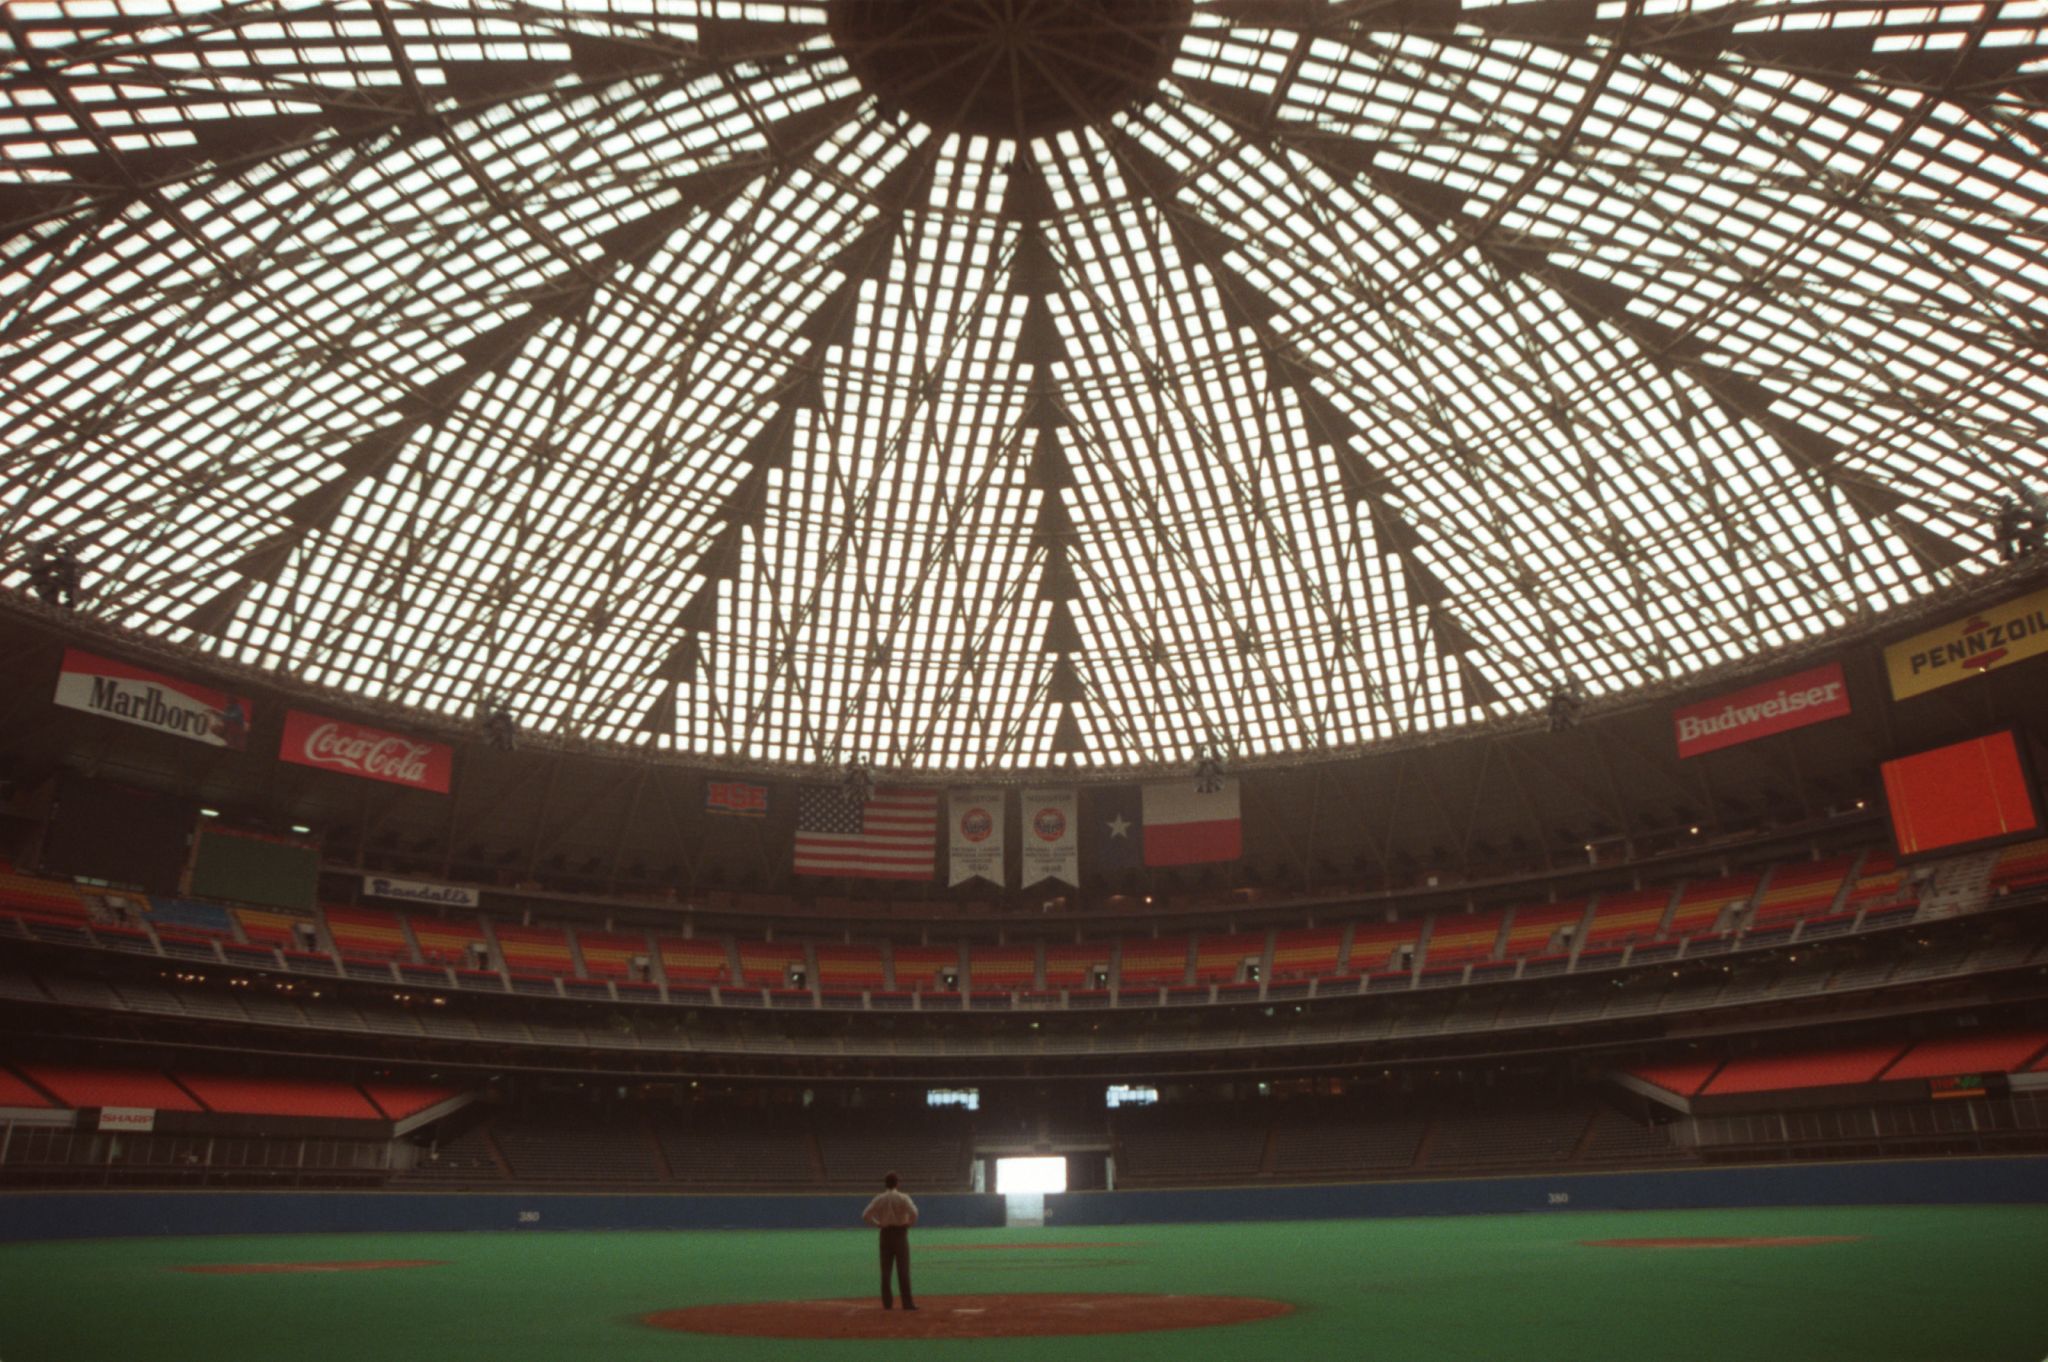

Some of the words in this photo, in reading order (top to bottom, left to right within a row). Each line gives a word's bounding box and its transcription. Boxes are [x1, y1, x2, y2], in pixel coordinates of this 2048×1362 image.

[1910, 611, 2048, 675] PENNZOIL
[89, 676, 208, 735] Marlboro
[1678, 683, 1841, 742] Budweiser
[306, 723, 431, 780] Coca-Cola
[101, 1113, 153, 1124] SHARP
